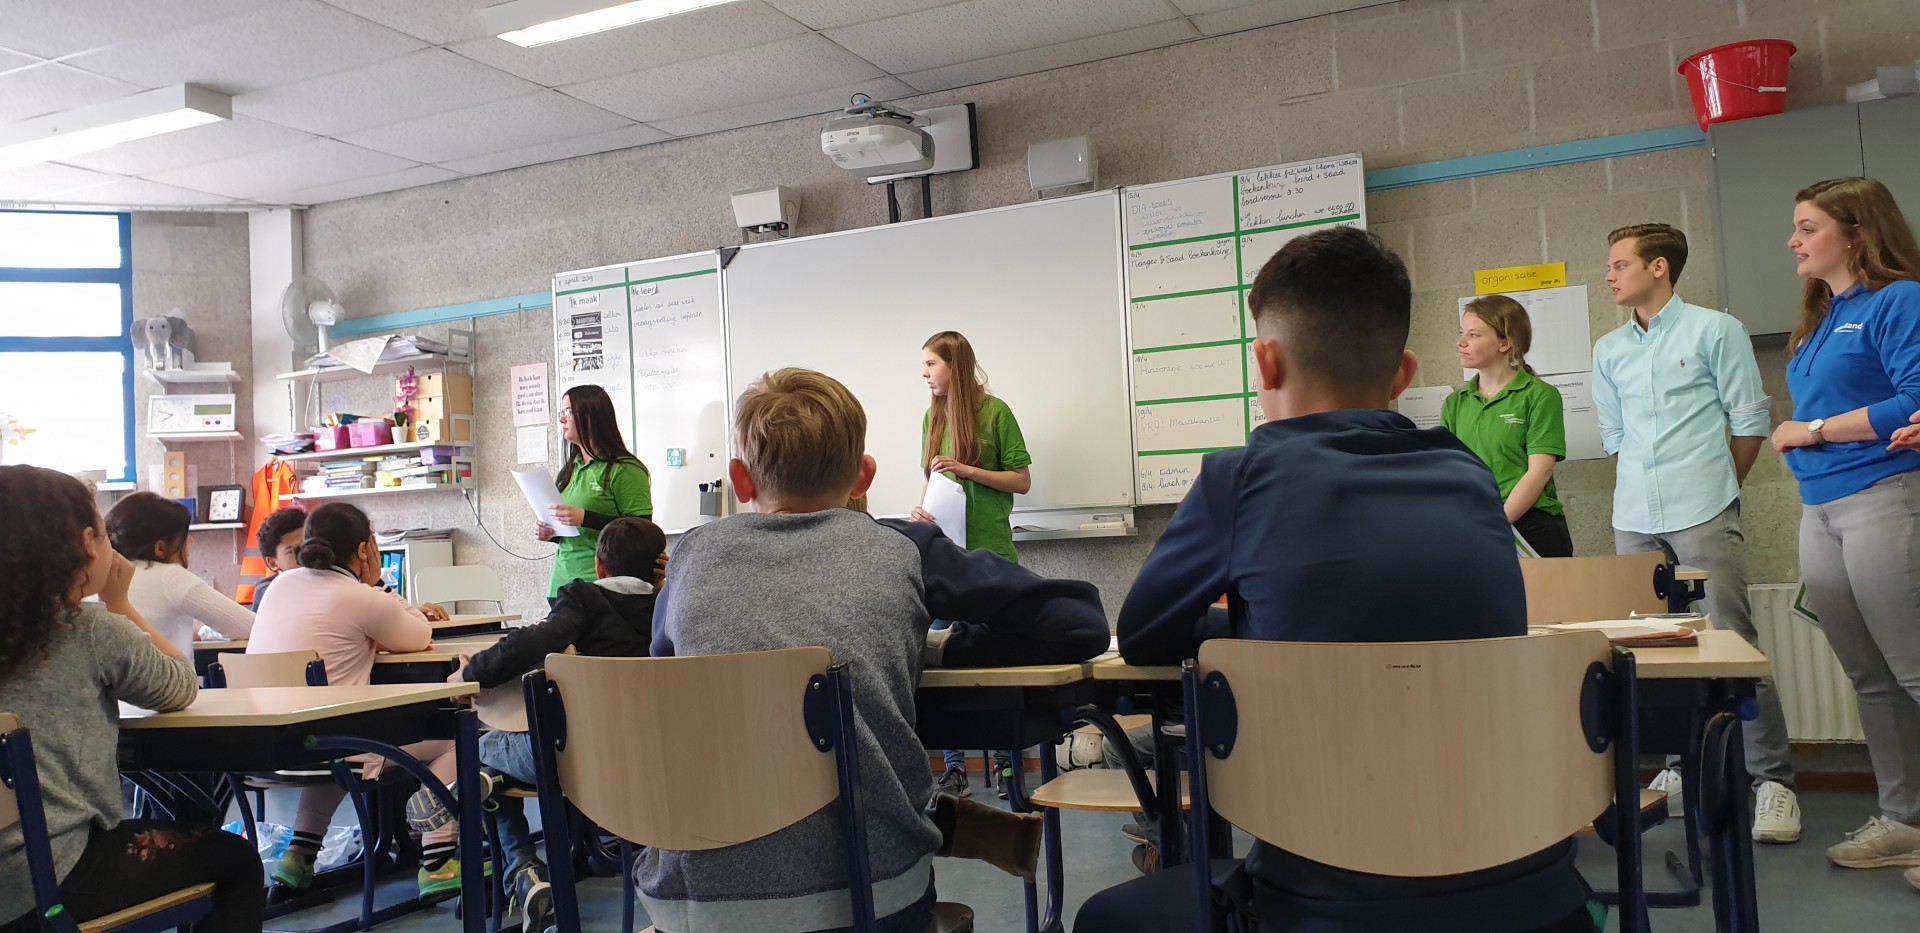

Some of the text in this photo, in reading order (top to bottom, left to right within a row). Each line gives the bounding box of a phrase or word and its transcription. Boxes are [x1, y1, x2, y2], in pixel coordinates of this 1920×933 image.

[1481, 271, 1537, 288] organisatie
[640, 286, 655, 295] leer
[578, 294, 598, 305] maak
